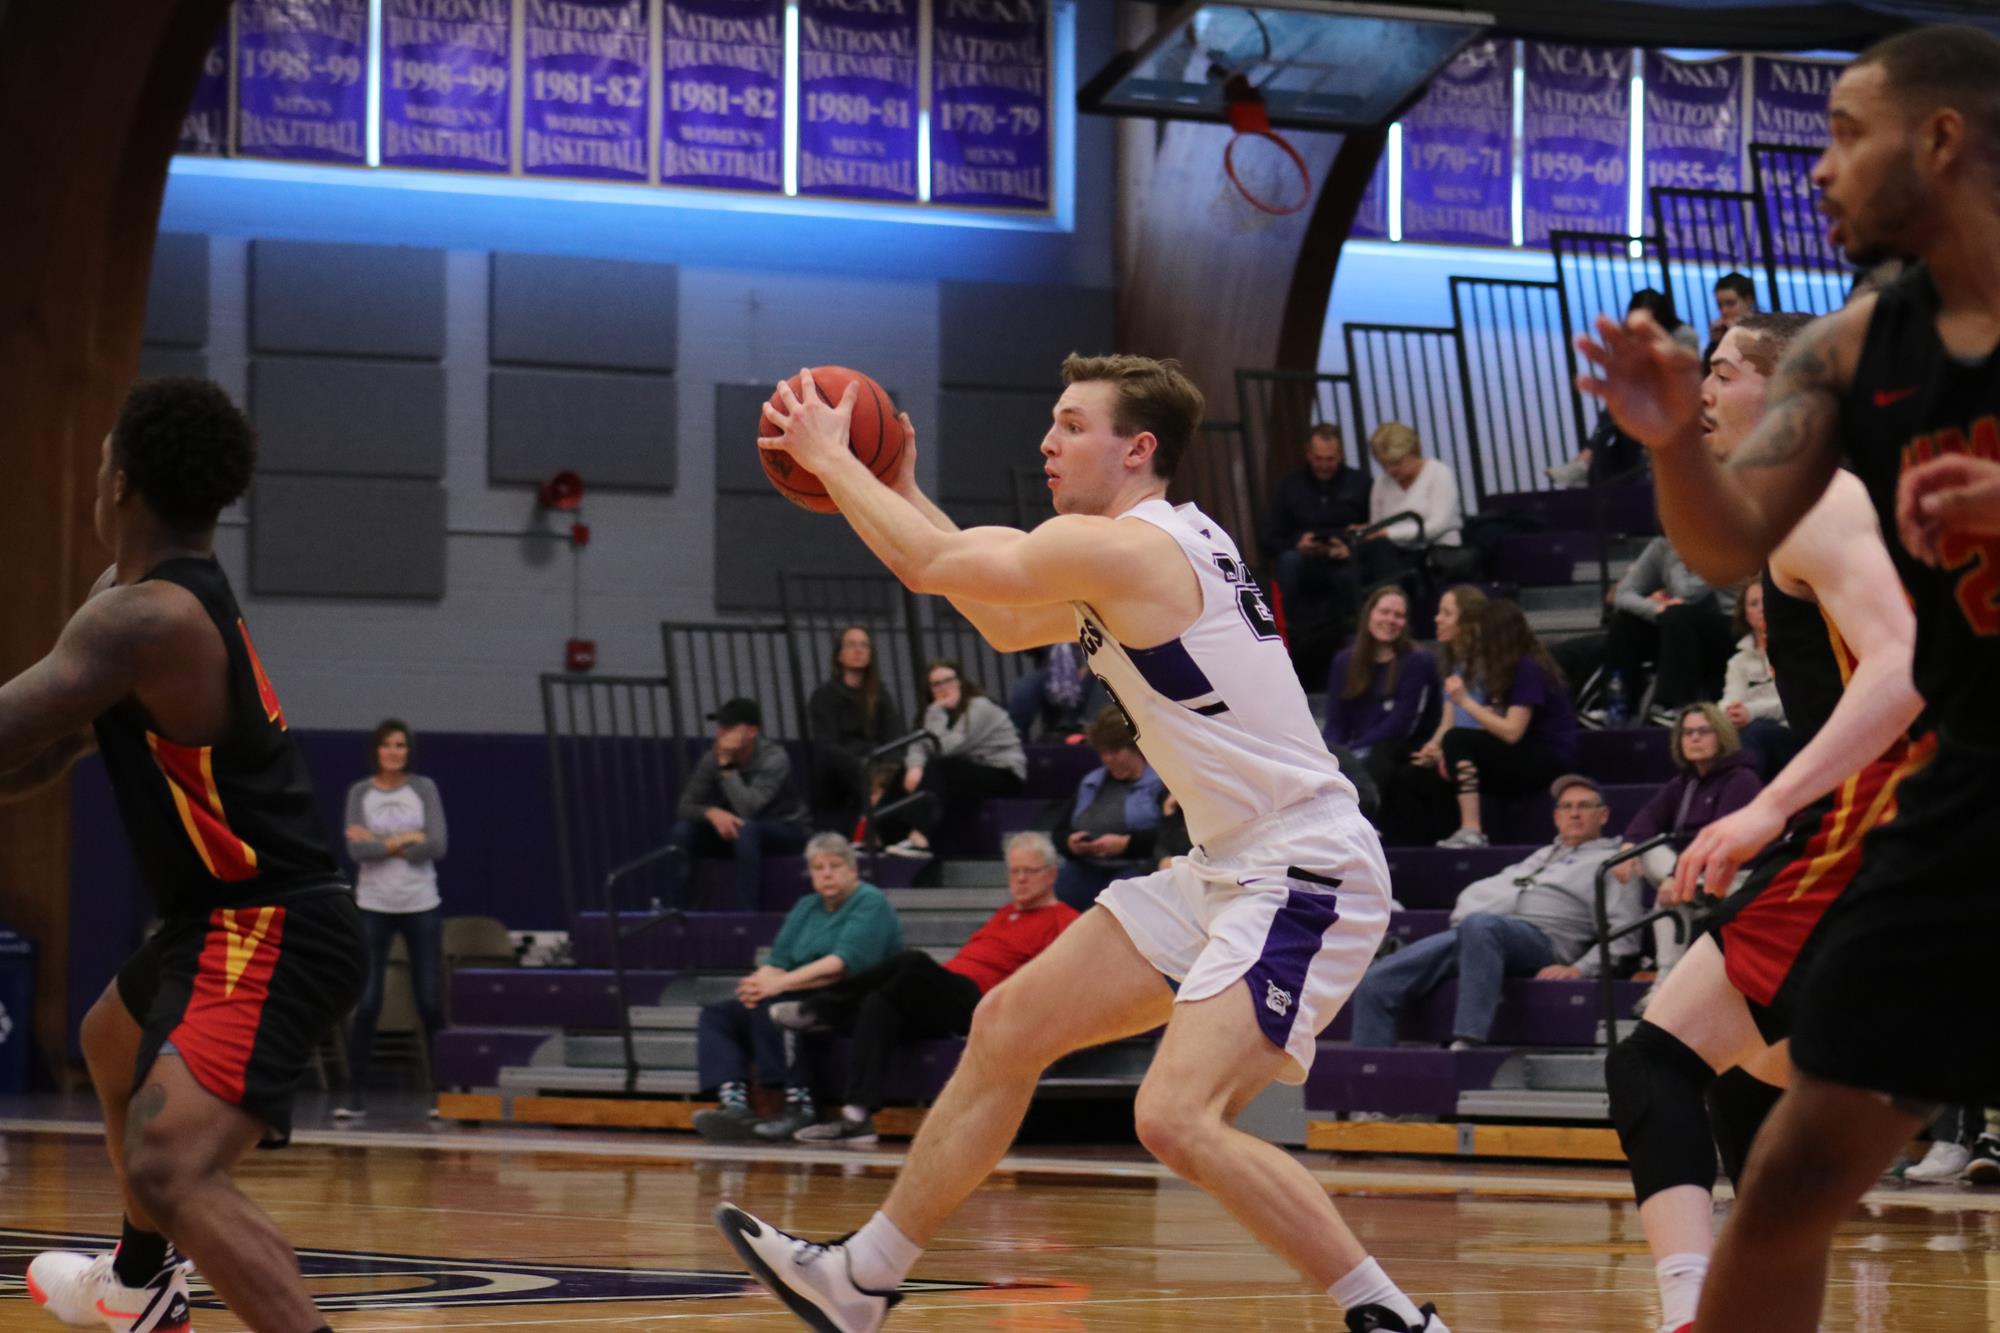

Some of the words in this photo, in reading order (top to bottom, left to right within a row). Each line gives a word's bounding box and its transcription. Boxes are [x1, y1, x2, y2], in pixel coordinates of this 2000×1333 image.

[667, 4, 781, 43] NATIONAL
[803, 18, 914, 56] NATIONAL
[935, 33, 1042, 66] NATIONAL
[1536, 44, 1625, 80] NCAA
[533, 71, 643, 107] 1981-82
[669, 82, 777, 118] 1981-82
[1529, 80, 1625, 117] NATIONAL
[805, 93, 910, 129] 1980-81
[939, 103, 1041, 137] 1978-79
[528, 129, 647, 175] BASKETBALL
[665, 140, 781, 185] BASKETBALL
[1411, 144, 1500, 177] 1970-71
[1530, 153, 1624, 186] 1959-60
[802, 150, 915, 196] BASKETBALL
[935, 160, 1045, 201] BASKETBALL
